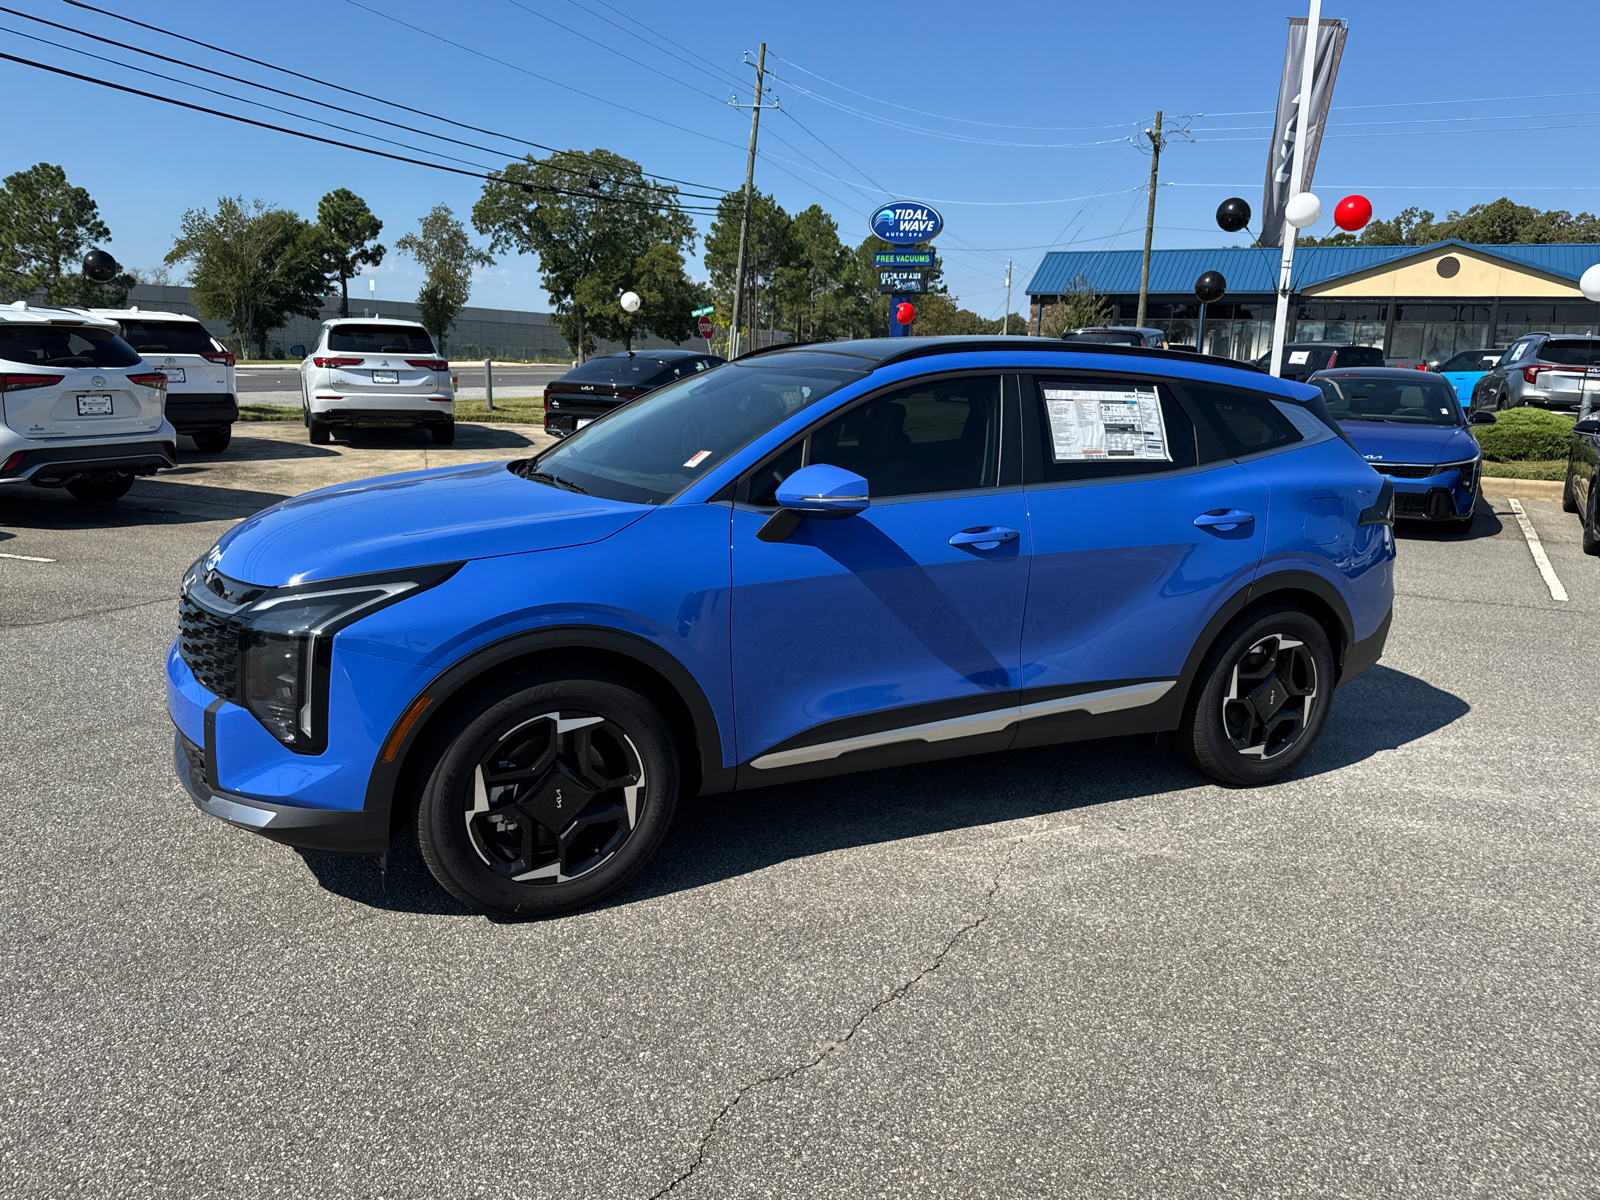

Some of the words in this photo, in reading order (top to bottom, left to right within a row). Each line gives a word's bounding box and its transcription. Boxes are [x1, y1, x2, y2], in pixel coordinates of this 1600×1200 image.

[895, 209, 928, 220] TIDAL
[900, 221, 935, 231] WAVE
[699, 323, 713, 332] STOP
[439, 773, 454, 848] CRUGEN
